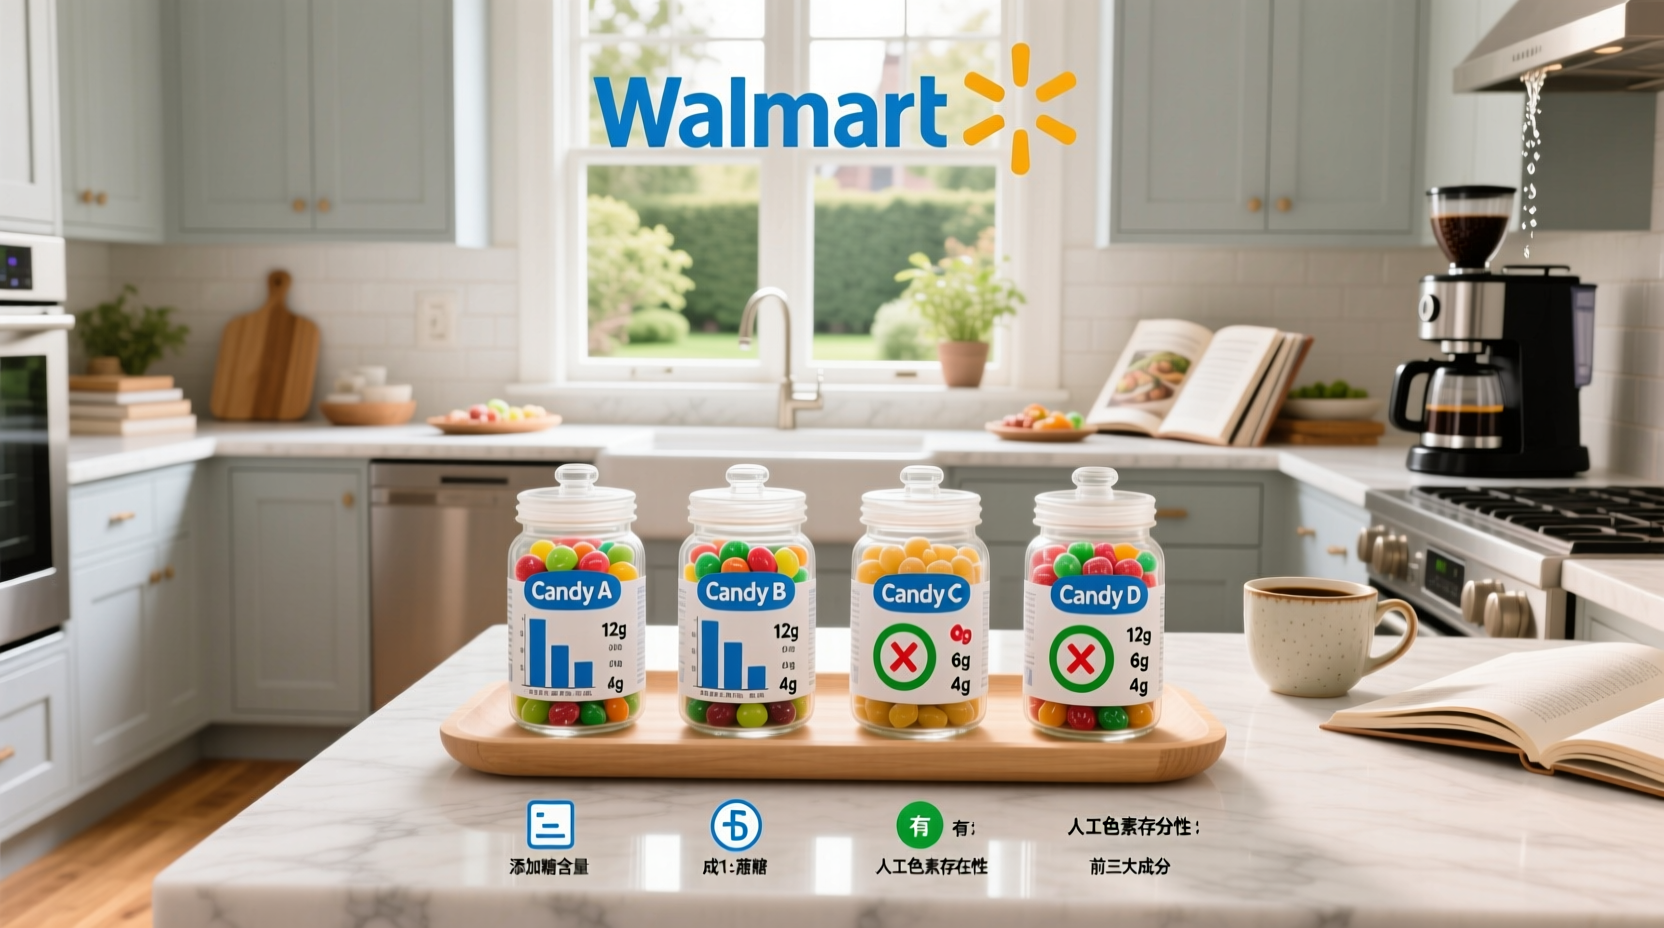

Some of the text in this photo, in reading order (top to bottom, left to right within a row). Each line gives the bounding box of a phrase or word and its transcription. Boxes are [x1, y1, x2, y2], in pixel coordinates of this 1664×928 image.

[531, 580, 613, 606] Candy A
[706, 581, 787, 607] Candy B
[881, 583, 963, 609] Candy C
[1059, 584, 1141, 610] Candy D
[601, 622, 627, 640] 12g
[773, 623, 799, 642] 12g
[1126, 626, 1152, 646] 12g
[951, 652, 971, 671] 6g
[1130, 652, 1149, 672] 6g
[607, 676, 624, 693] 4g
[779, 677, 798, 695] 4g
[950, 676, 971, 696] 4g
[1129, 678, 1148, 697] 4g
